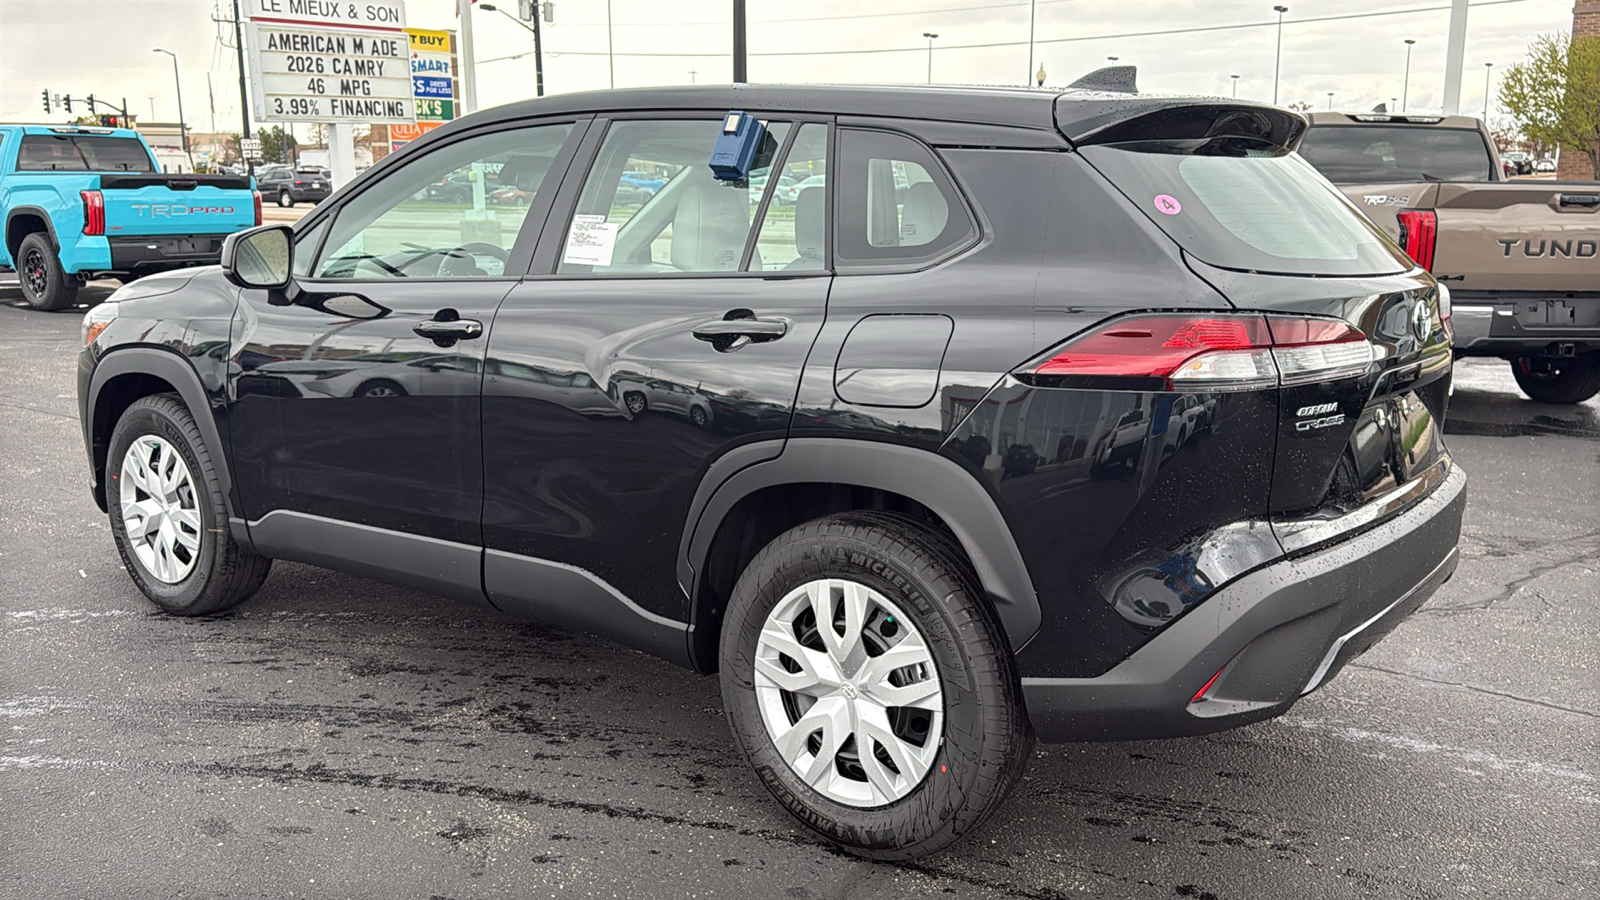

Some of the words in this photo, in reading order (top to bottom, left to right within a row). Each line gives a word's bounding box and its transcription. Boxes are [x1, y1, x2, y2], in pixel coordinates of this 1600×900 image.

[260, 0, 282, 13] LE
[289, 0, 341, 18] MIEUX
[348, 3, 359, 19] &
[366, 5, 399, 23] SON
[268, 33, 346, 54] AMERICAN
[419, 35, 445, 46] BUY
[286, 55, 324, 73] 2026
[332, 58, 385, 77] CAMRY
[307, 78, 325, 94] 46
[340, 79, 371, 96] MPG
[426, 86, 438, 94] FOR
[438, 87, 452, 95] LESS
[429, 80, 447, 88] DRESS
[274, 98, 320, 115] 3.99%
[330, 99, 404, 117] FINANCING
[131, 204, 188, 219] TRD
[189, 206, 234, 214] PRO
[1162, 199, 1176, 210] 4
[1496, 238, 1597, 258] TUND
[850, 552, 930, 614] MICHELIN
